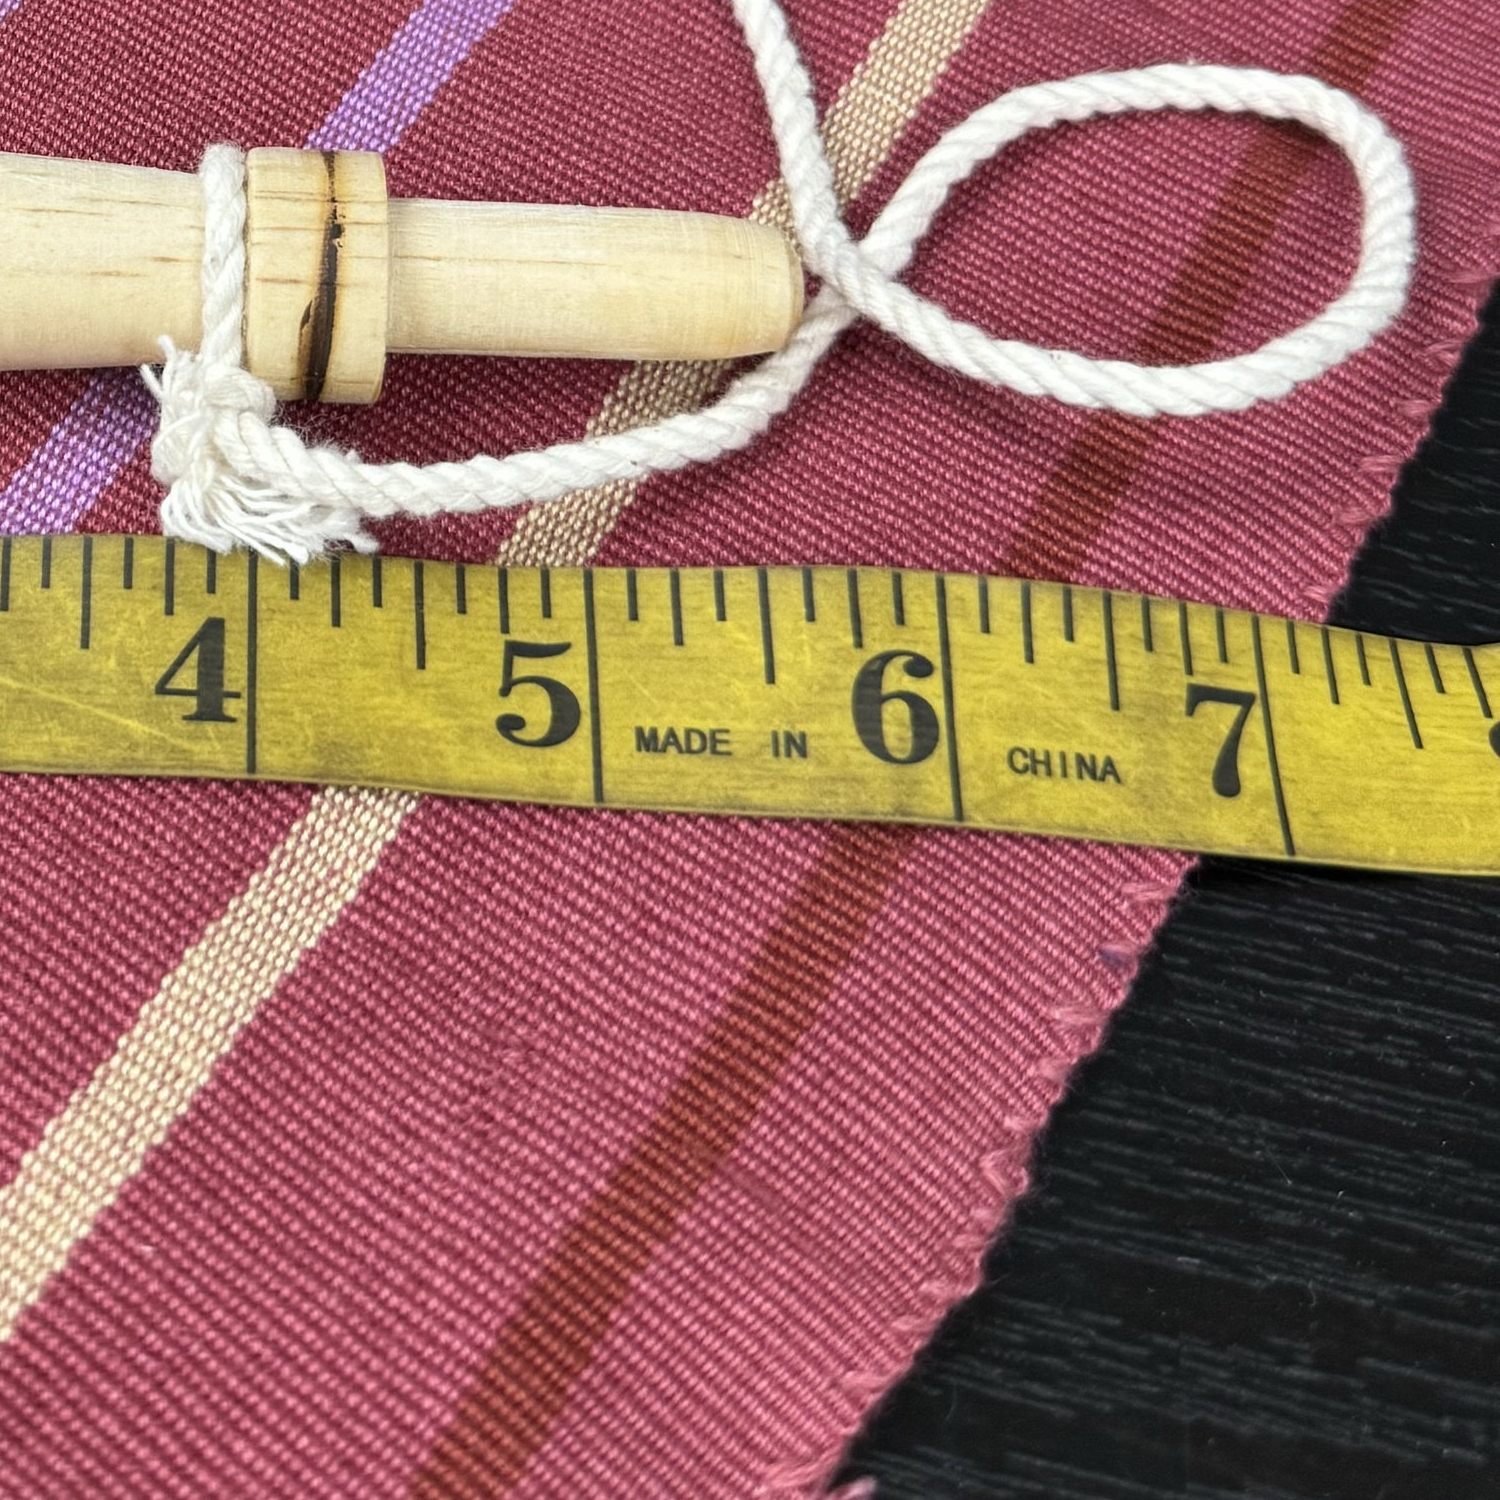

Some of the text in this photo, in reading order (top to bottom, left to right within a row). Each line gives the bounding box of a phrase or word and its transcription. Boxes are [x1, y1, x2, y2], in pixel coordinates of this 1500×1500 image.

[155, 617, 242, 723] 4
[495, 641, 581, 748] 5
[851, 649, 940, 765] 6
[1185, 684, 1256, 797] 7
[635, 726, 1122, 785] MADE IN CHINA
